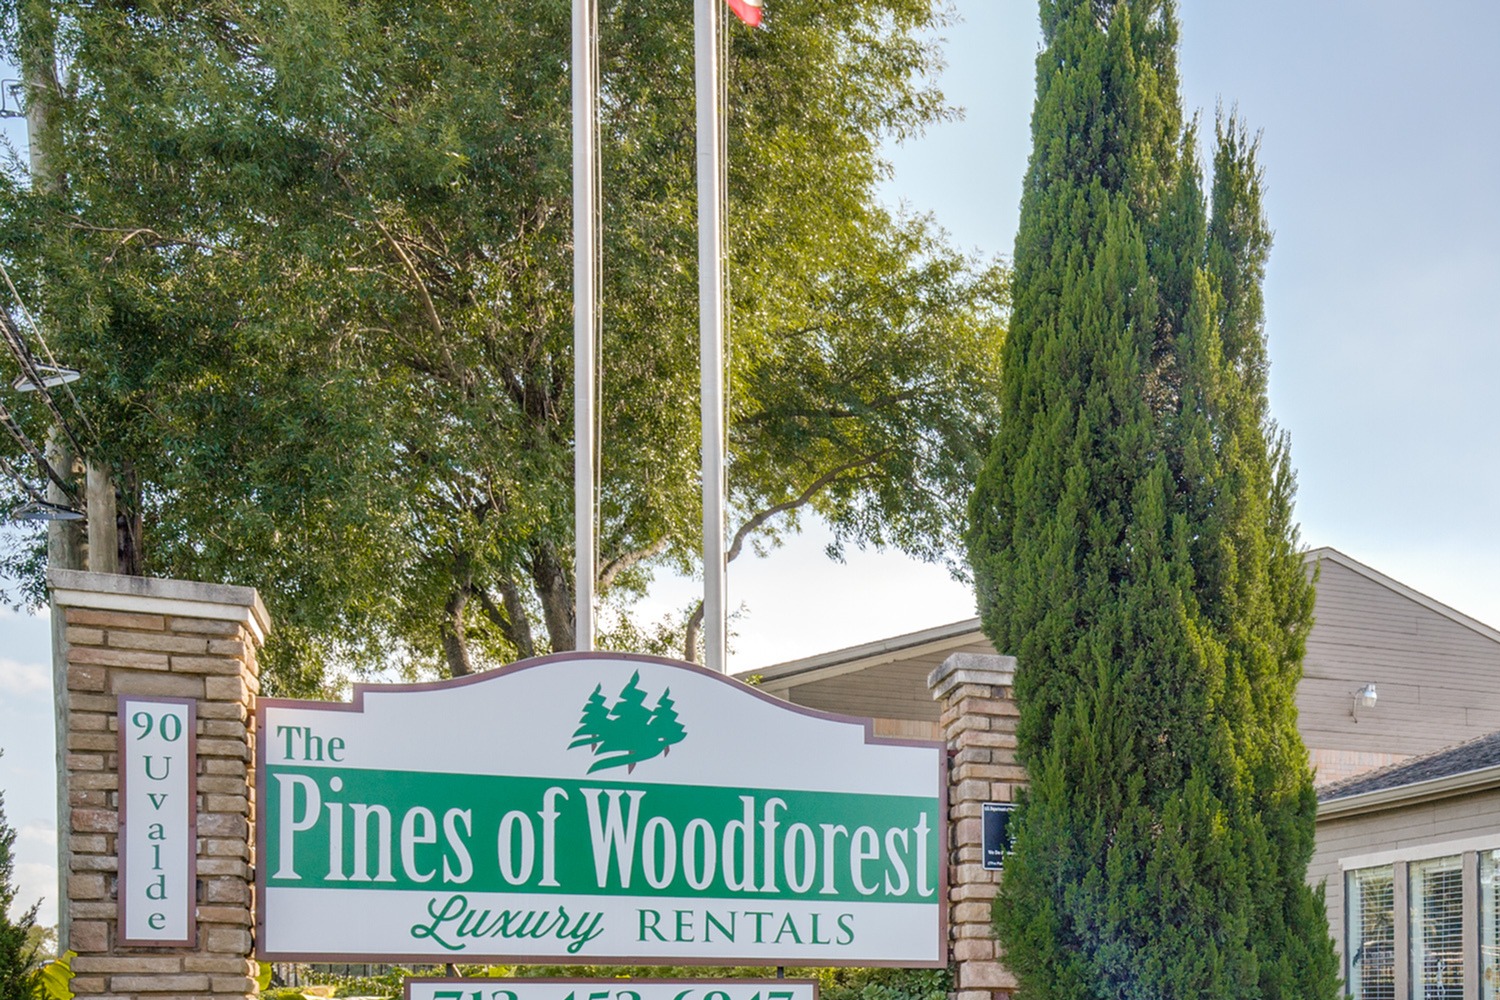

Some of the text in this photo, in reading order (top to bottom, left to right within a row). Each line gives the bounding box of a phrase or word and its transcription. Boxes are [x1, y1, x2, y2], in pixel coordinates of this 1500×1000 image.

[132, 711, 182, 742] 90
[276, 725, 346, 763] The
[143, 755, 172, 930] Uvalde
[271, 773, 935, 897] Pines of Woodforest
[410, 894, 855, 954] Luxury RENTALS
